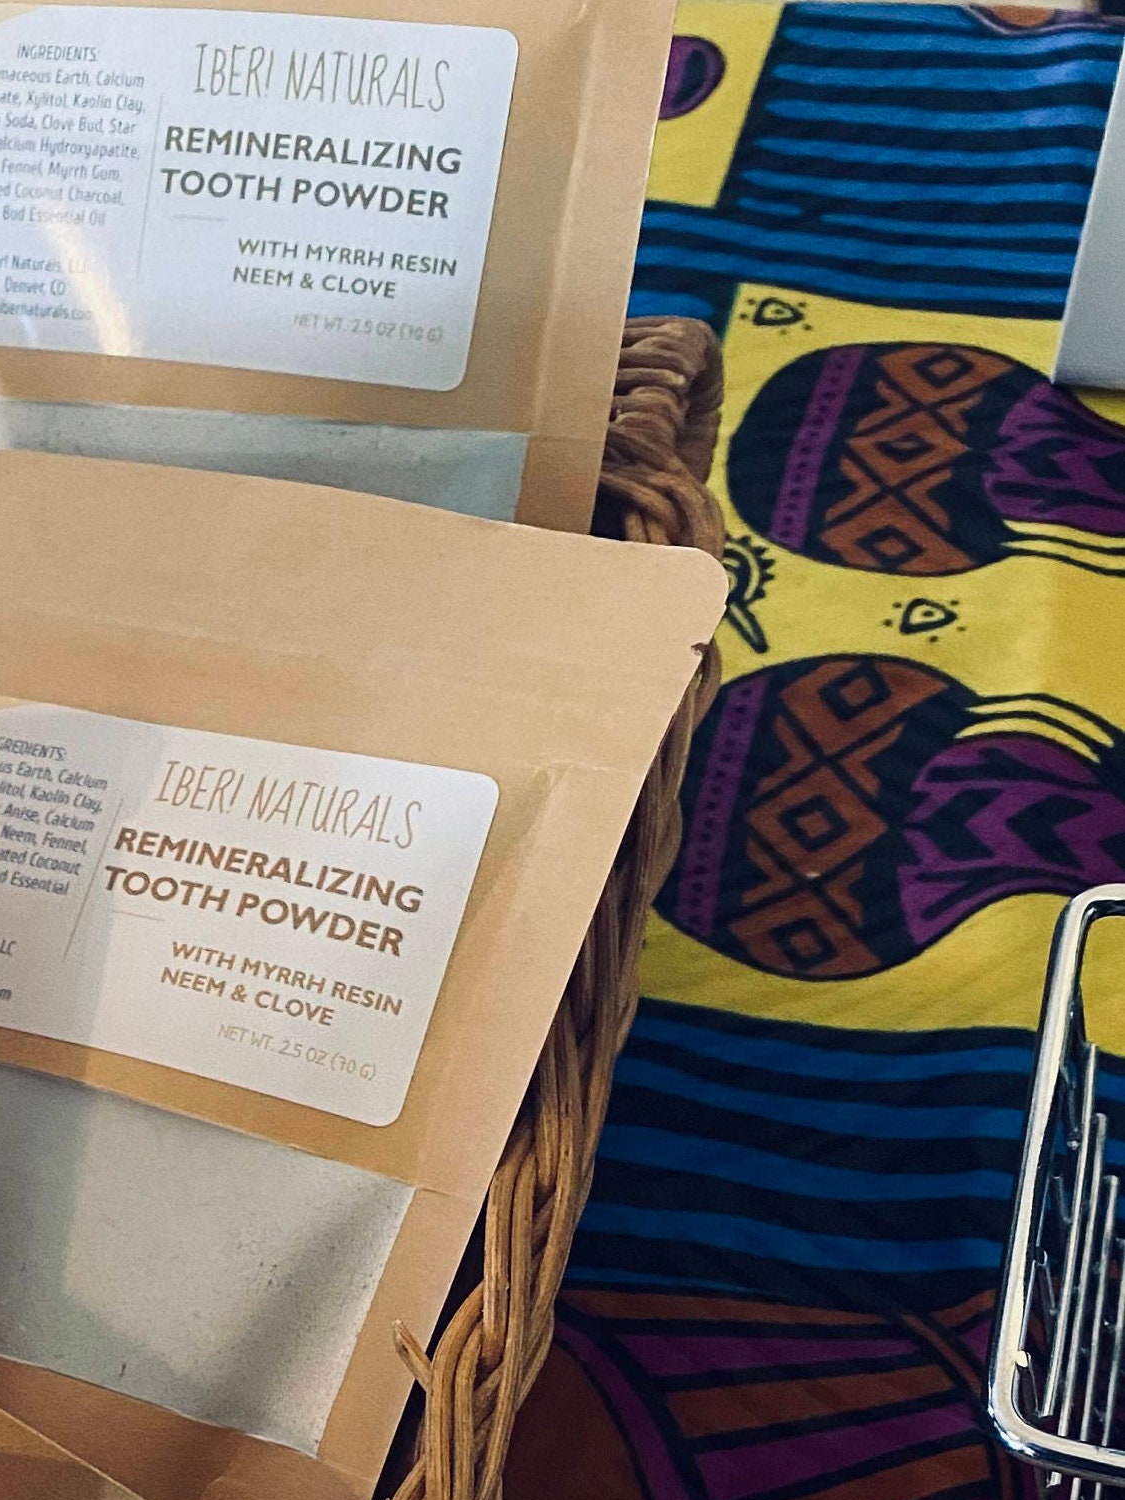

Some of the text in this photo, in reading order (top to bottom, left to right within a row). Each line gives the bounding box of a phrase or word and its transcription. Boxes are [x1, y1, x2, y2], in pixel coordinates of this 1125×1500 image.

[95, 69, 145, 88] Calcium
[284, 50, 450, 113] NATURALS
[164, 125, 462, 175] REMINERALIZING
[160, 168, 449, 219] TOOTH POWDER
[233, 266, 397, 299] NEEM & CLOVE
[238, 238, 458, 277] WITH MYRRH RESIN
[246, 775, 422, 850] NATURALS
[113, 827, 424, 914] REMINERALIZING
[104, 865, 404, 957] TOOTH POWDER
[160, 966, 336, 1026] NEEM & CLOVE
[172, 941, 403, 1016] WITH MYRRH RESIN
[217, 1023, 250, 1043] NET
[305, 1046, 330, 1067] OZ
